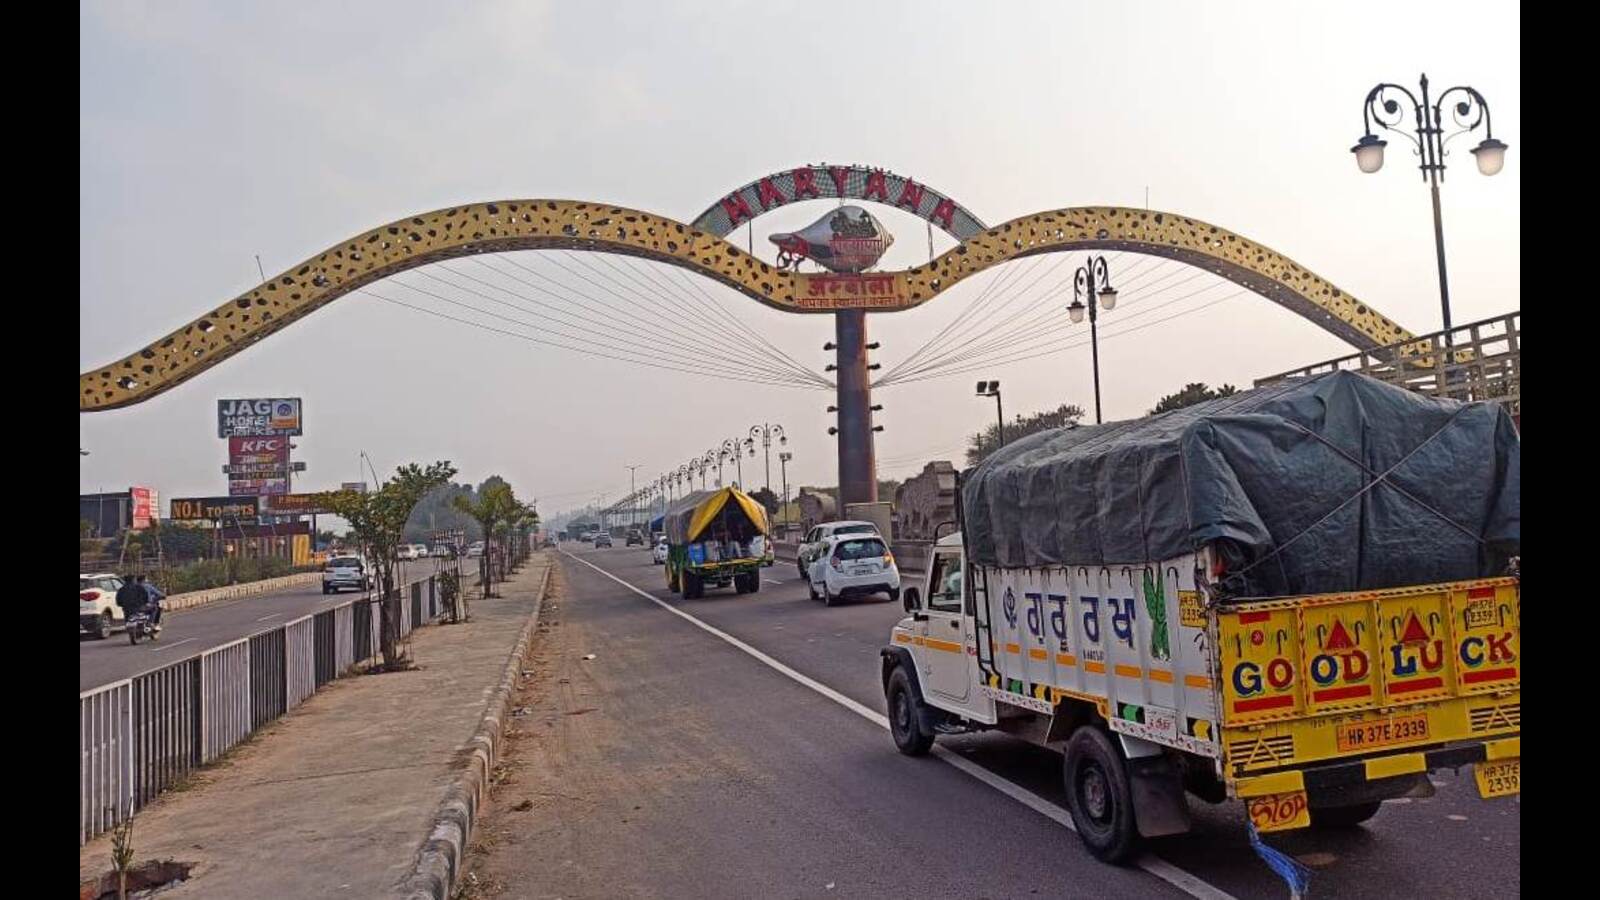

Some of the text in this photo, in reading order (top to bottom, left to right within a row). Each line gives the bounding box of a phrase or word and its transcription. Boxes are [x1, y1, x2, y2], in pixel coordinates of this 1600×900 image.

[723, 165, 956, 225] HARYANA
[222, 400, 272, 415] JAG
[226, 416, 273, 426] HOTEL
[240, 440, 278, 452] KFC
[172, 500, 202, 518] NO.1
[1470, 610, 1493, 622] 2339
[1232, 632, 1518, 697] GOOD LUCK
[1348, 719, 1426, 744] HR 37E 2339
[1484, 762, 1519, 777] HR 37E
[1488, 775, 1518, 793] 2339
